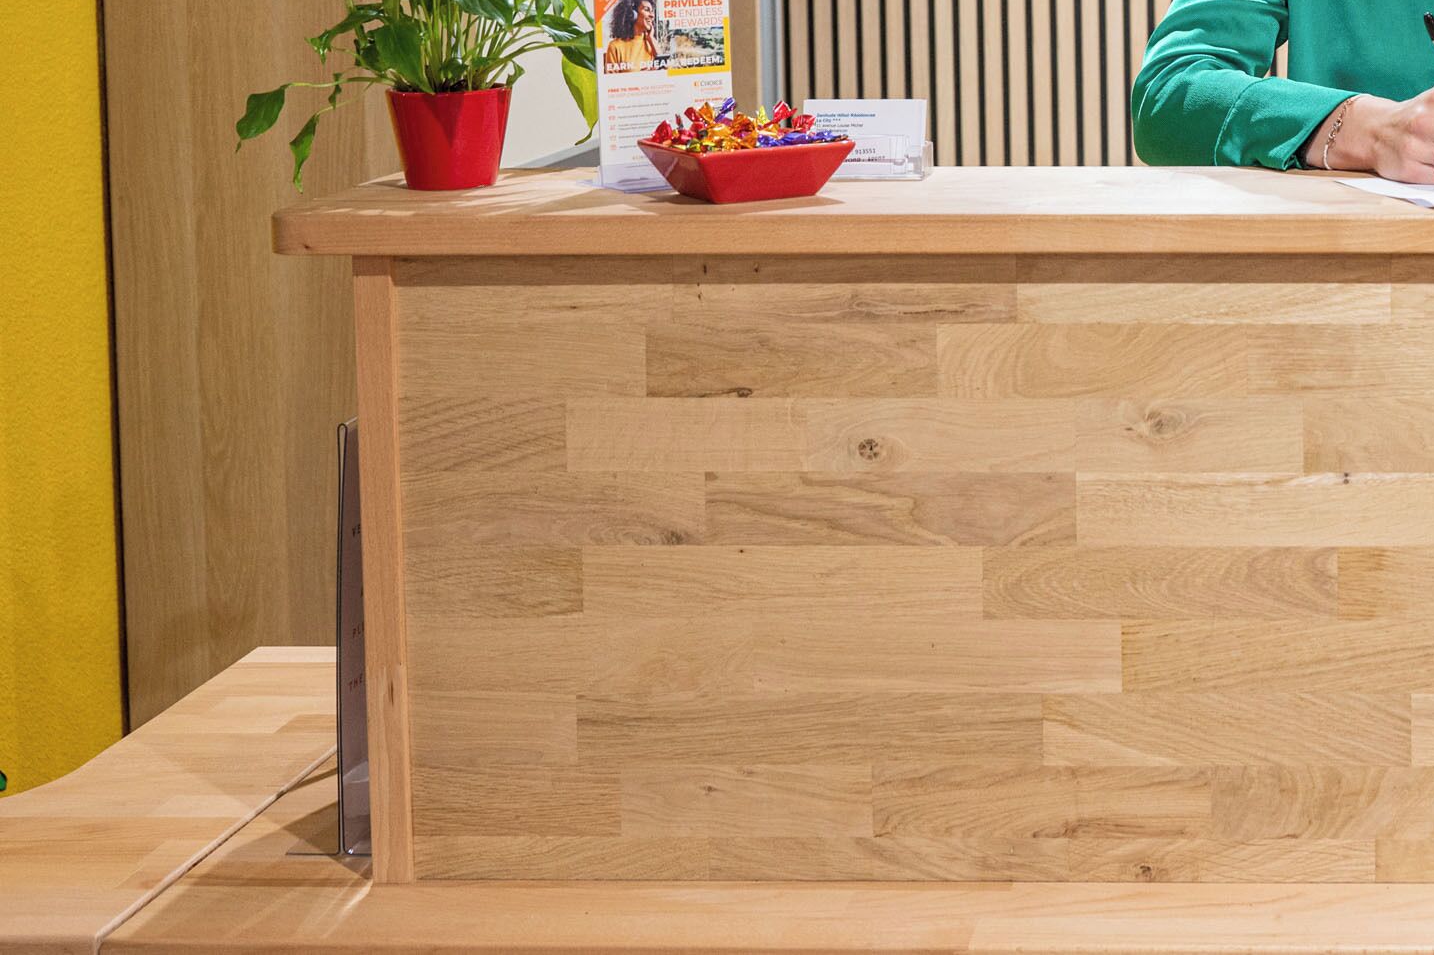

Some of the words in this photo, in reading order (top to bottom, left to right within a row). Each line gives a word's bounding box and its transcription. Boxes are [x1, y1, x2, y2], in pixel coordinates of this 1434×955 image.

[664, 9, 677, 19] IS:
[679, 7, 723, 18] ENDLESS
[674, 16, 723, 27] REWARDS
